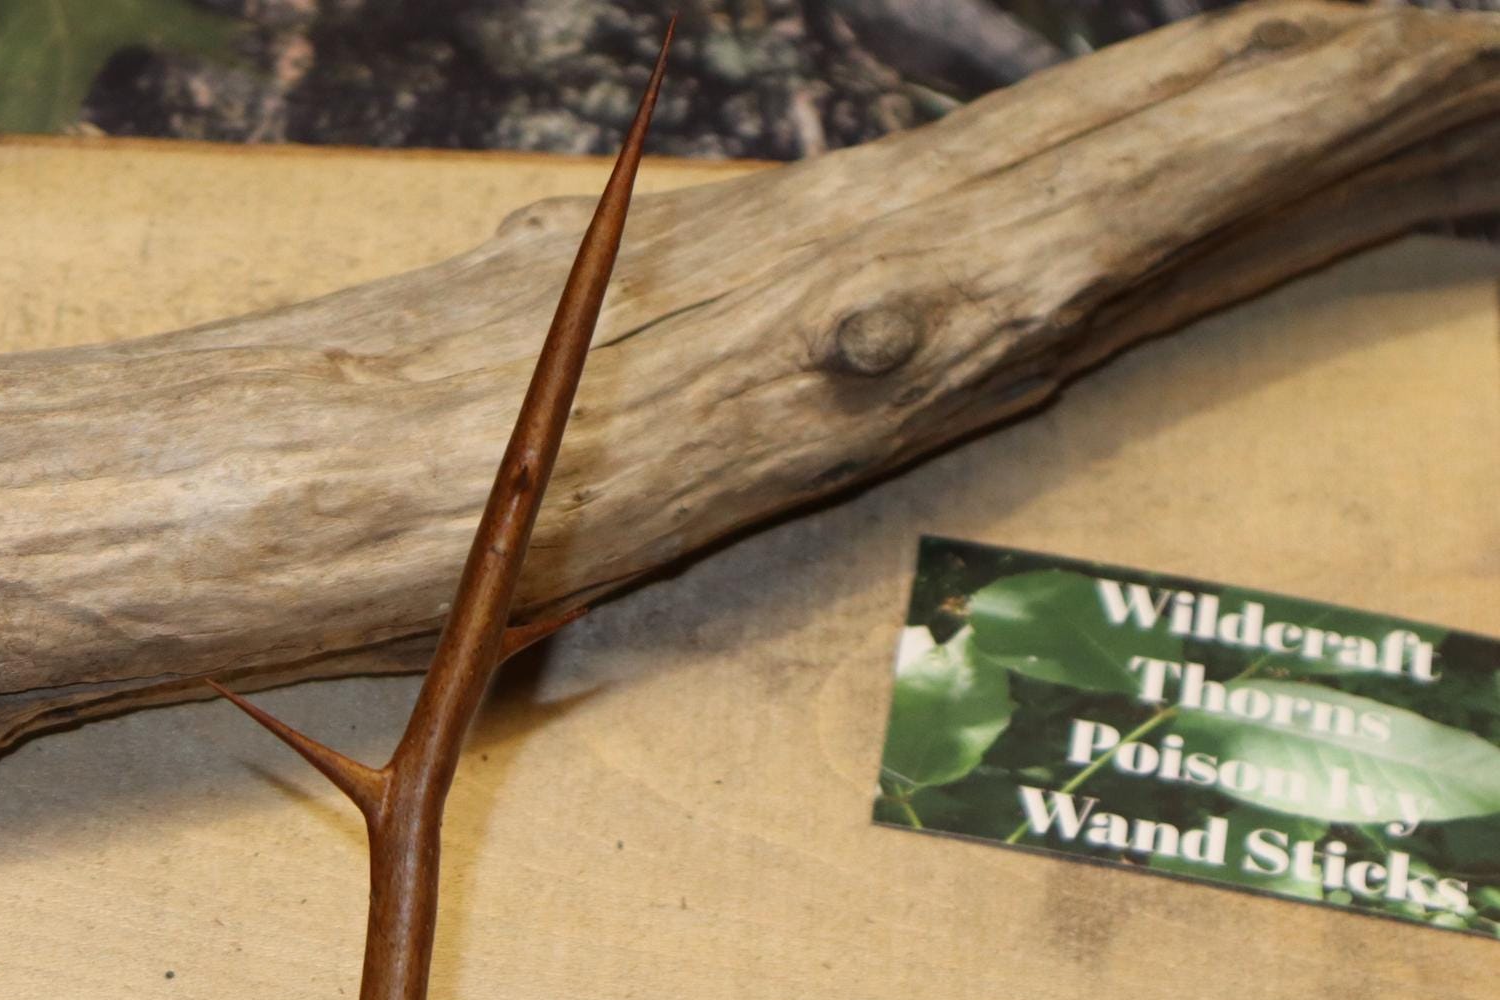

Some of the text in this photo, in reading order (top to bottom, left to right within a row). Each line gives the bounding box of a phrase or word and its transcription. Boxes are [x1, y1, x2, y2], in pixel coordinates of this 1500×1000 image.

[1096, 578, 1442, 682] Wildcraft
[1127, 656, 1393, 744] Thorns
[1066, 719, 1430, 837] Poison Ivy
[1017, 785, 1470, 914] Wand Sticks
